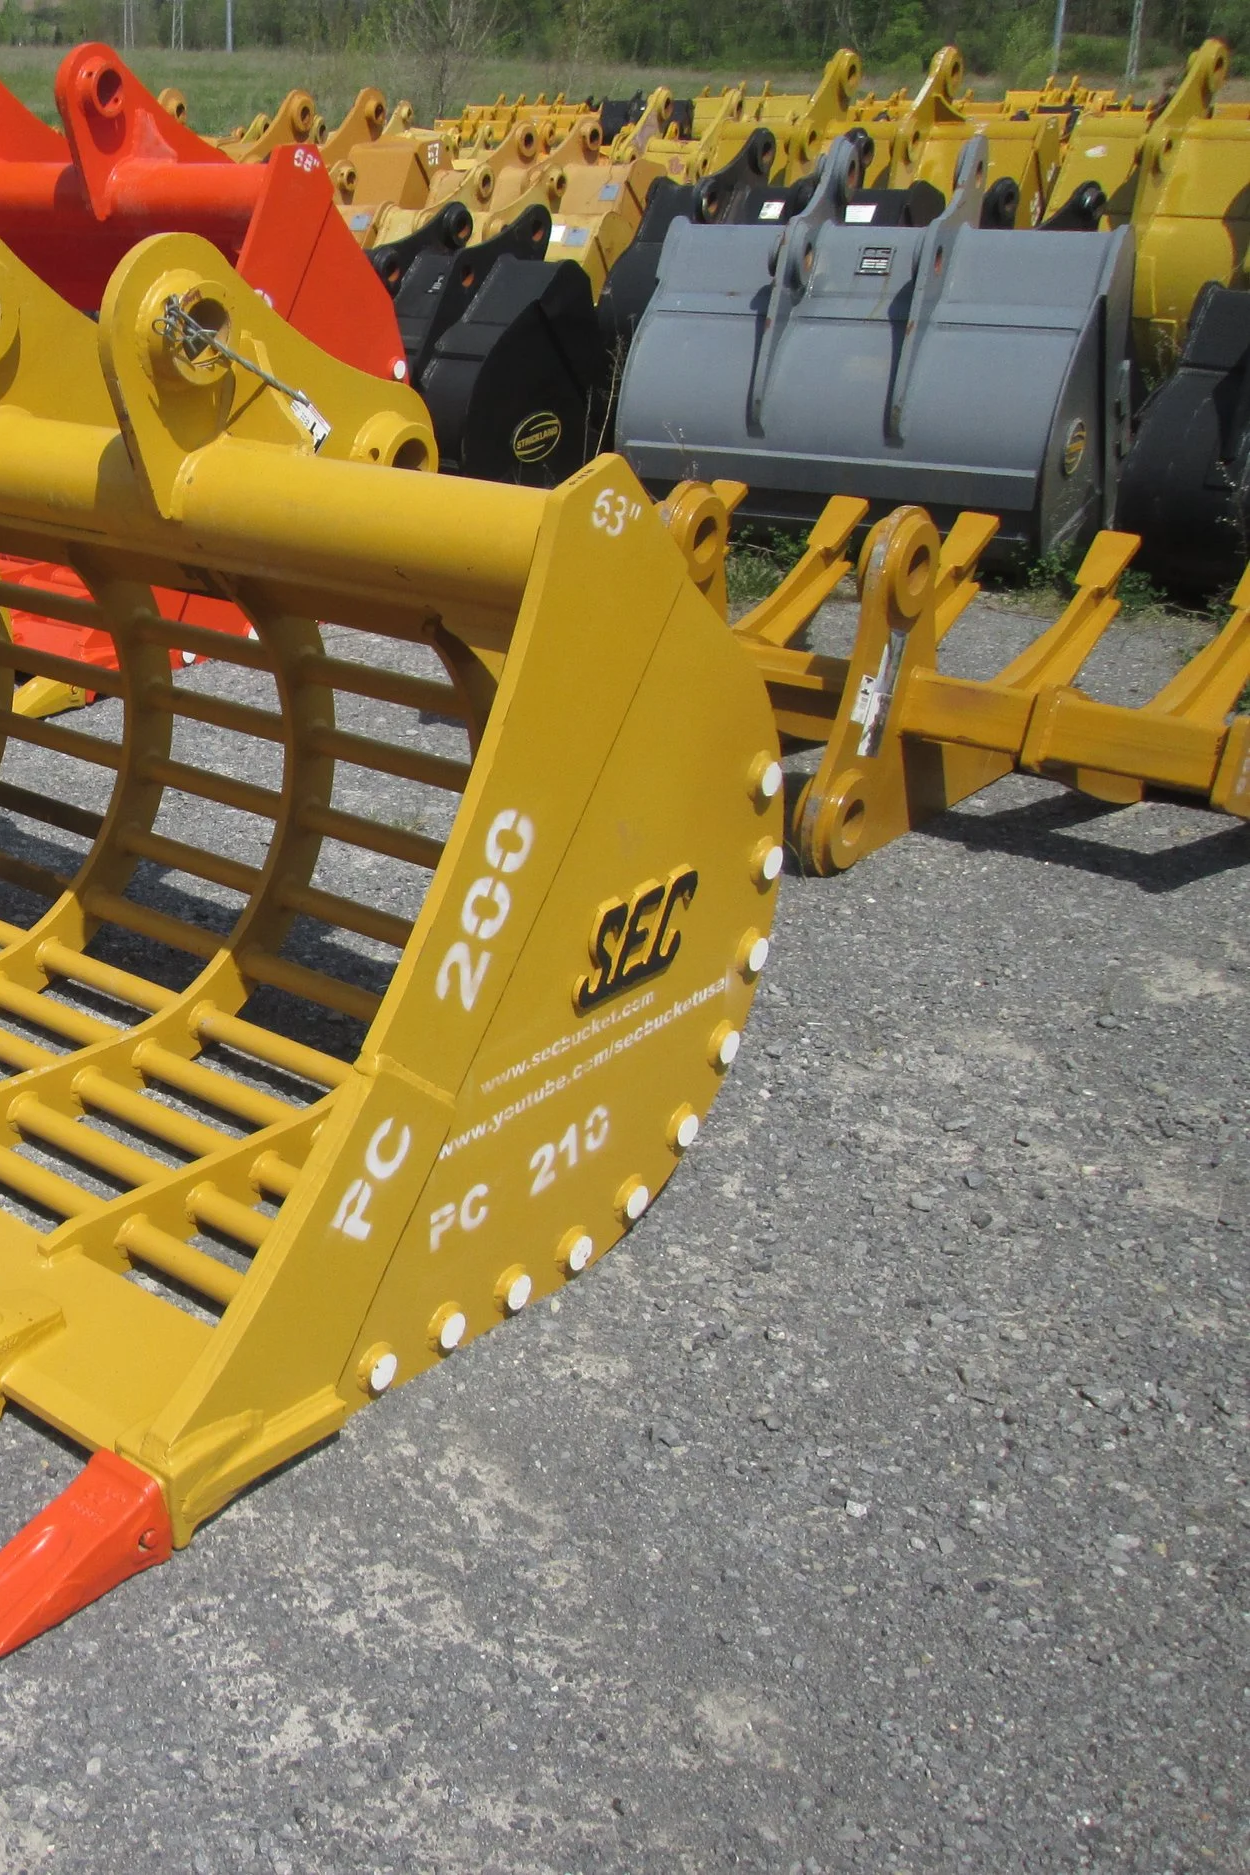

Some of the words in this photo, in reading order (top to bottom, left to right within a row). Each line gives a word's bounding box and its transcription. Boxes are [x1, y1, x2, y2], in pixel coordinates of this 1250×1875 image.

[591, 487, 642, 537] 63"
[571, 863, 699, 1010] SEC
[330, 1115, 412, 1243] PC
[434, 807, 536, 1013] 200
[479, 988, 656, 1096] www.secbucket.com
[429, 1182, 491, 1254] PC
[527, 1102, 611, 1199] 210
